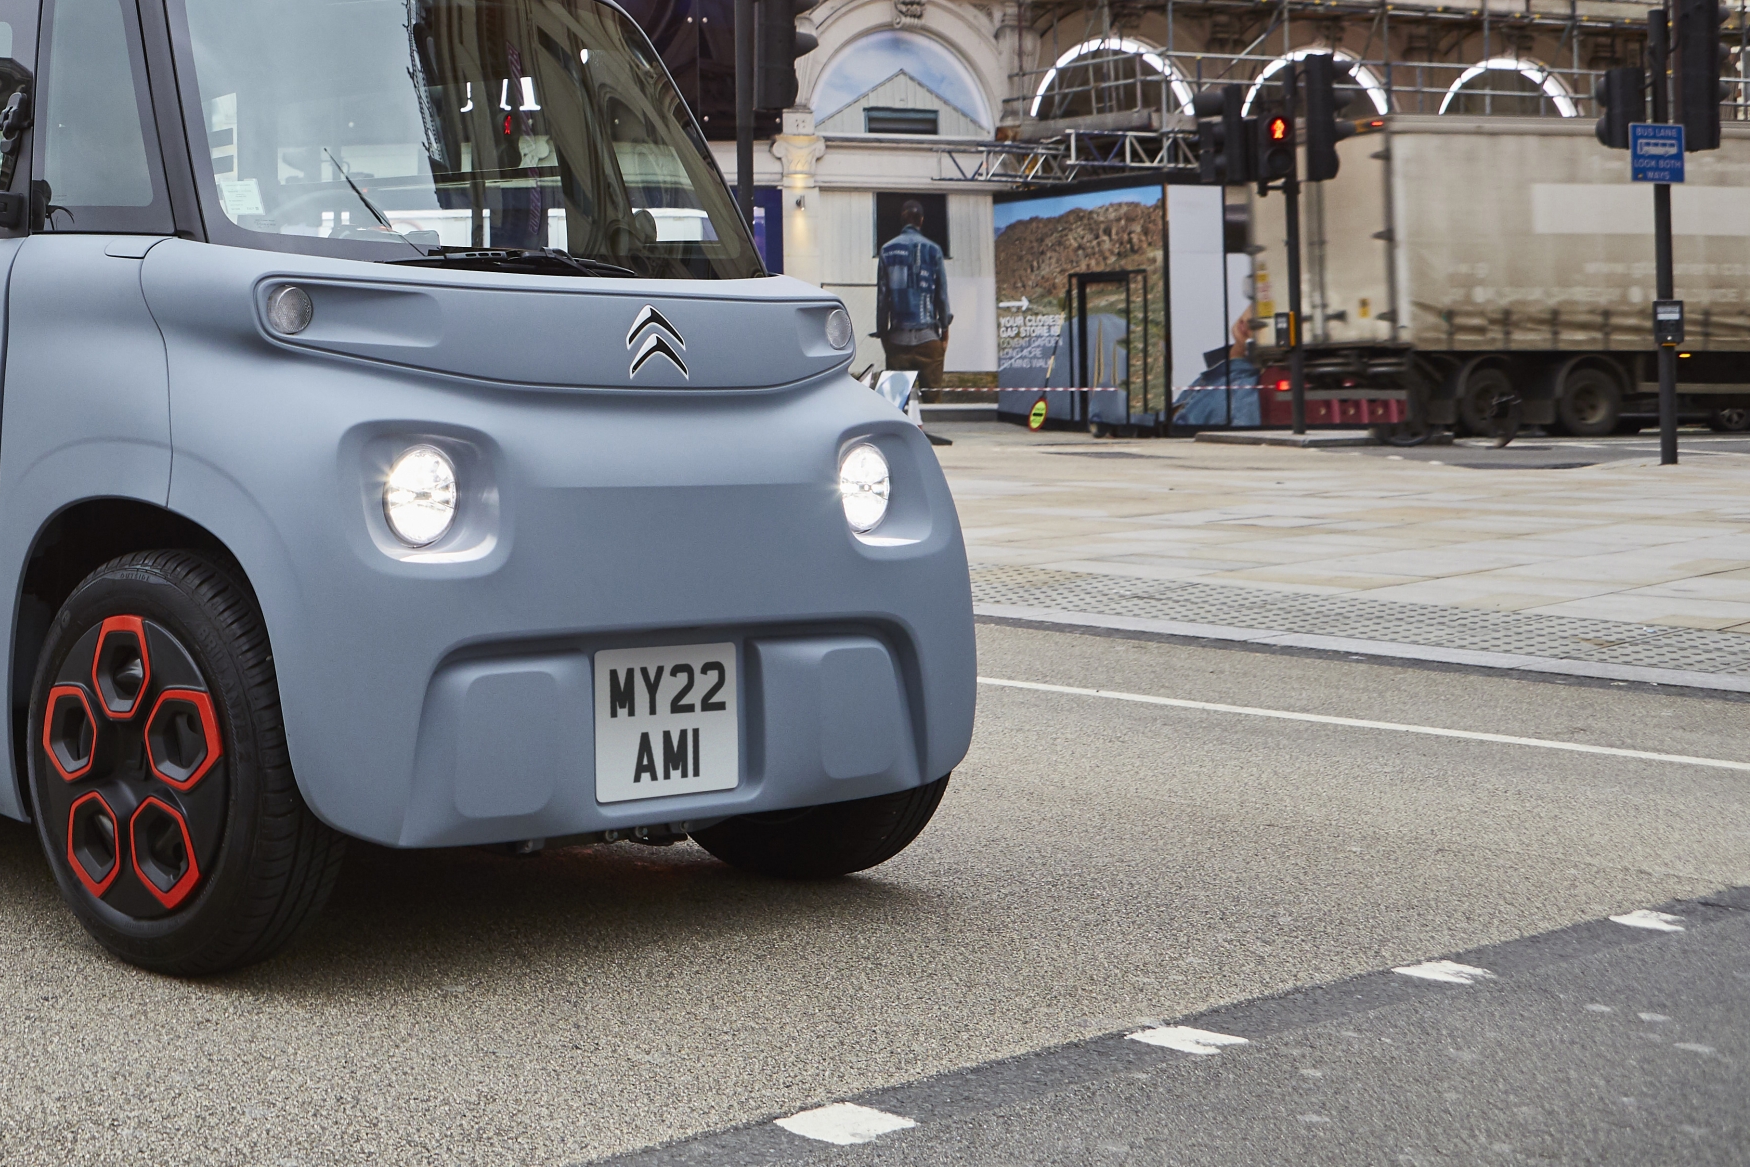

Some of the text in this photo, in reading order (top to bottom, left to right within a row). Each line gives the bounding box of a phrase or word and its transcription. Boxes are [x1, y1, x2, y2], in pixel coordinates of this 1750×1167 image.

[1636, 126, 1677, 137] BUS LANE
[1634, 159, 1681, 169] LOOK BOTH
[1646, 171, 1670, 180] WAYS
[999, 316, 1024, 327] YOUR
[999, 327, 1018, 338] GAP
[1019, 326, 1050, 337] STORE
[609, 660, 727, 718] MY22
[633, 727, 701, 783] AMI
